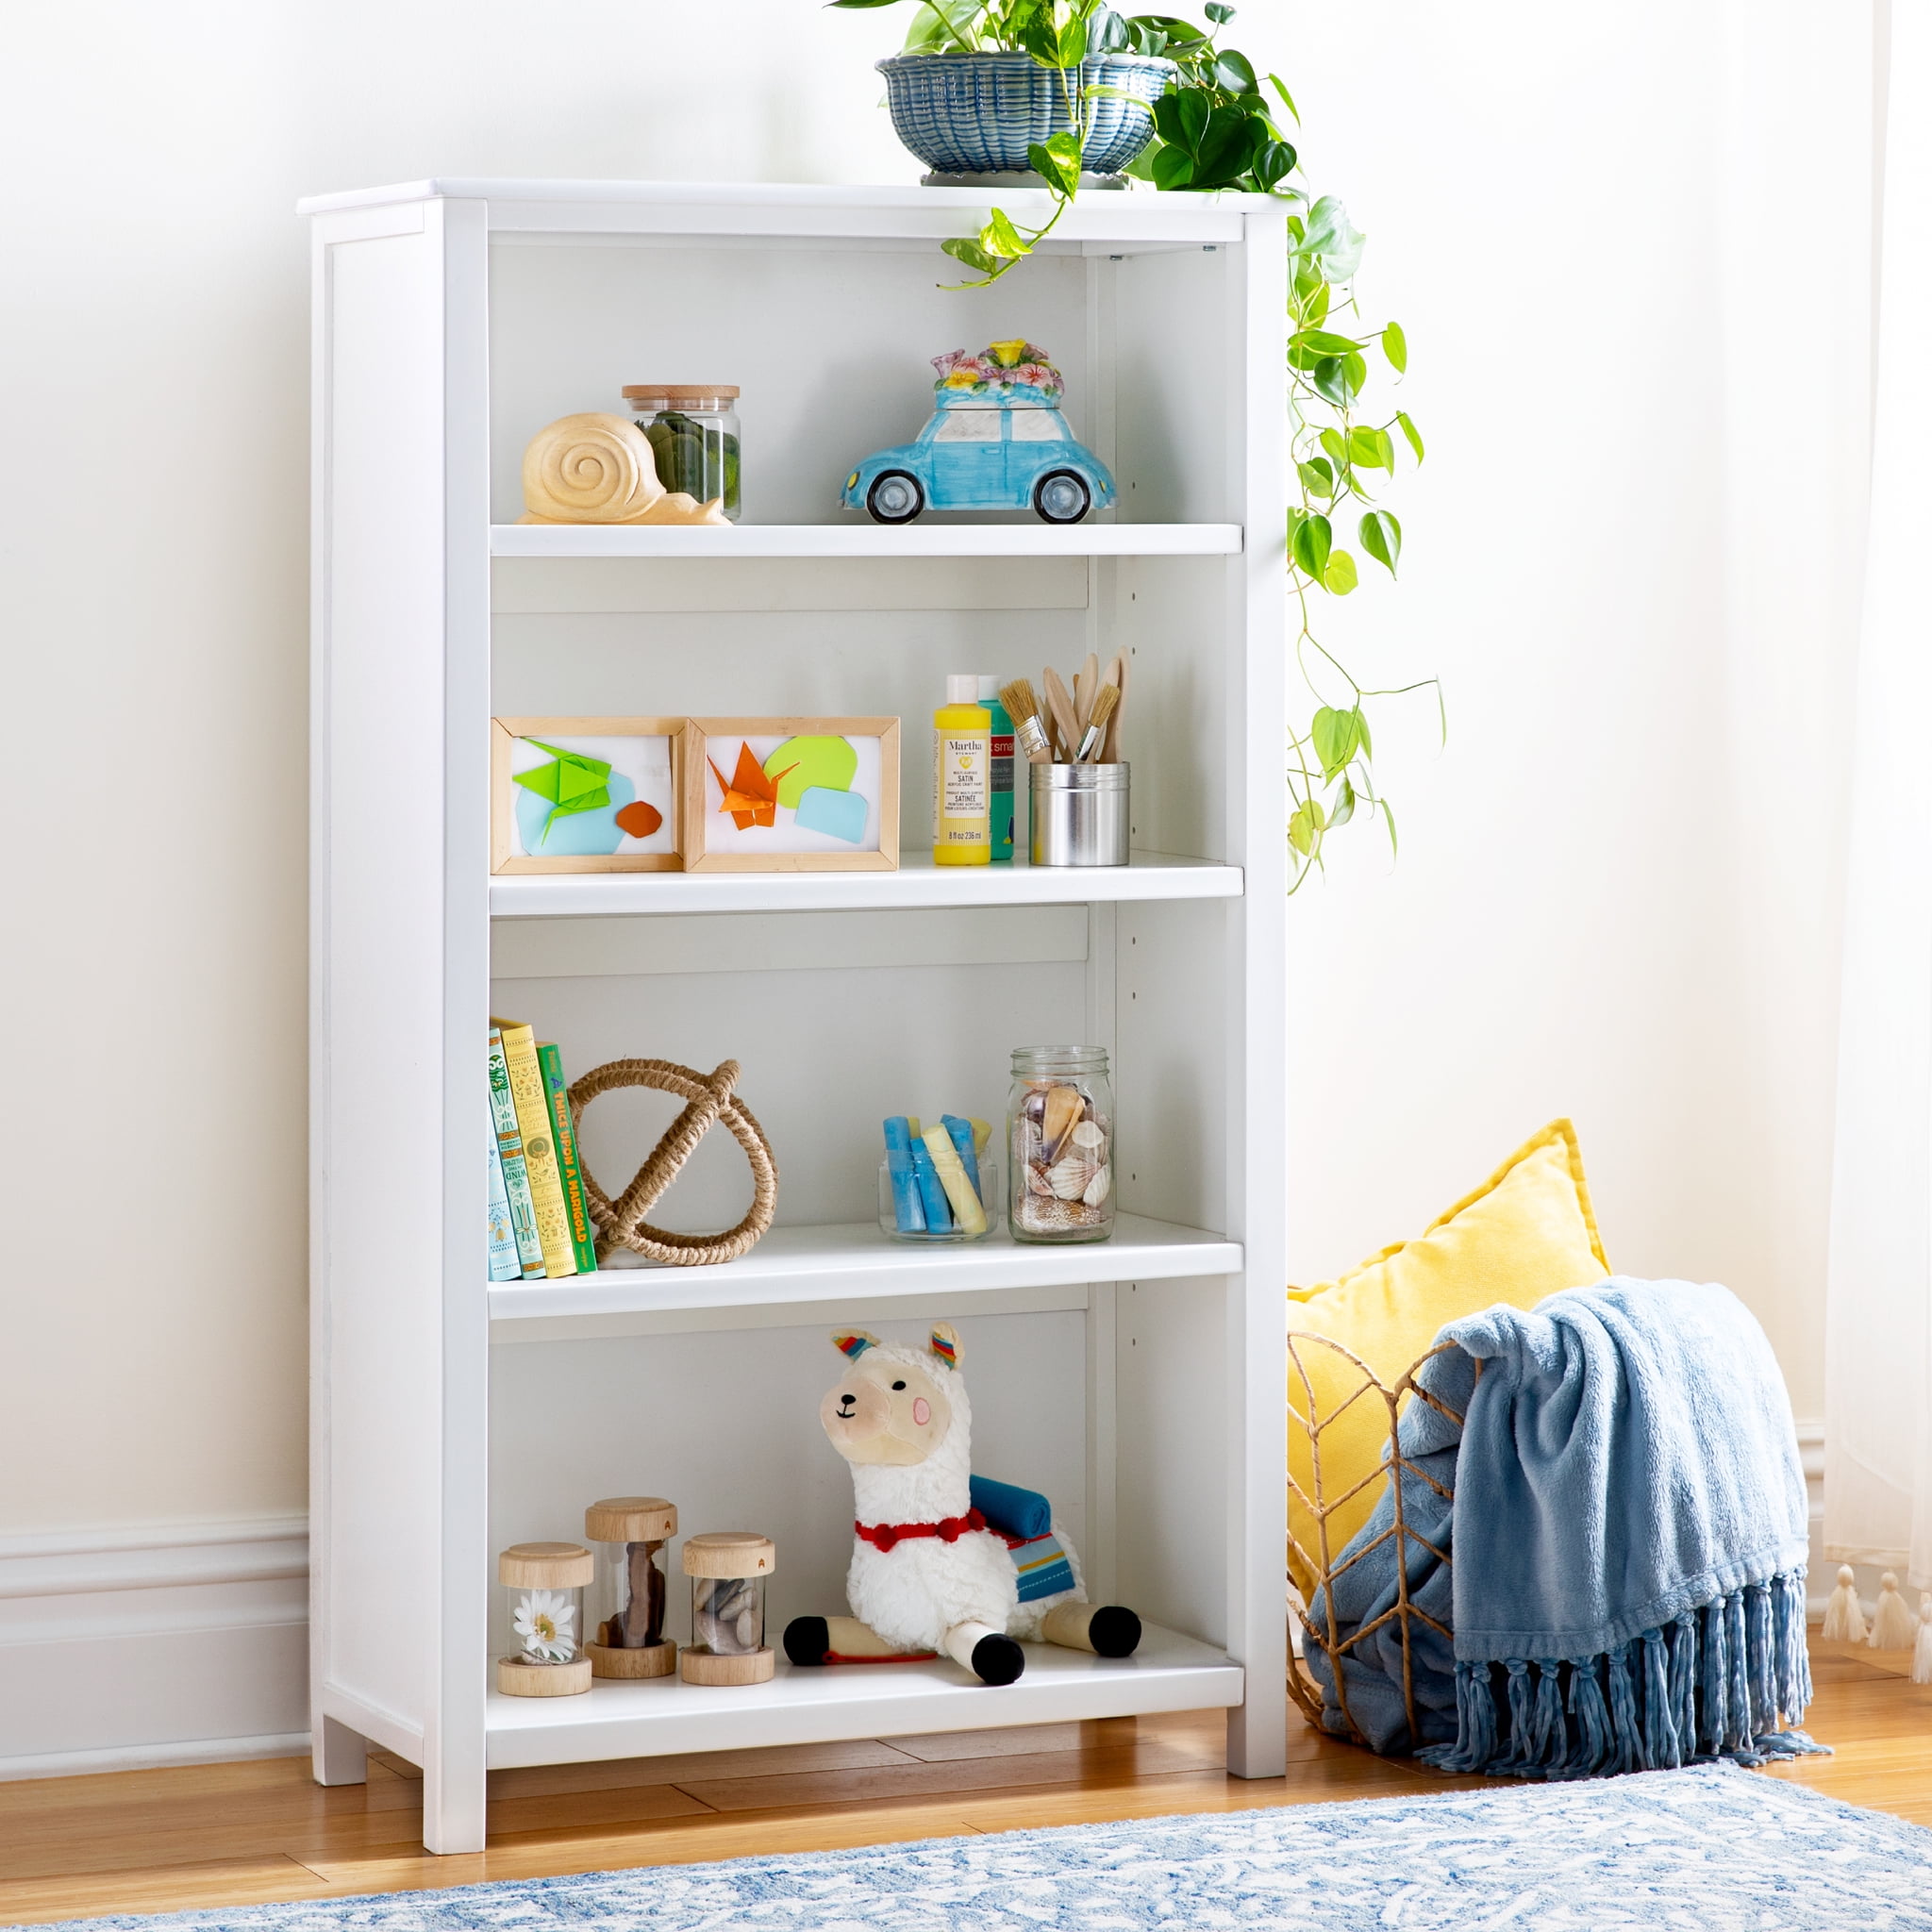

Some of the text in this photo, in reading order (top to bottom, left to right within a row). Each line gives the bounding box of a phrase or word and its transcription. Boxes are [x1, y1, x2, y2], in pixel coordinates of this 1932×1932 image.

[949, 740, 982, 751] Martha
[949, 831, 953, 840] 8
[965, 831, 974, 840] 236
[553, 1091, 569, 1128] TWICE
[560, 1131, 574, 1166] UPON
[506, 1169, 526, 1180] WIND
[566, 1169, 575, 1178] A
[568, 1181, 587, 1243] MARIGOLD
